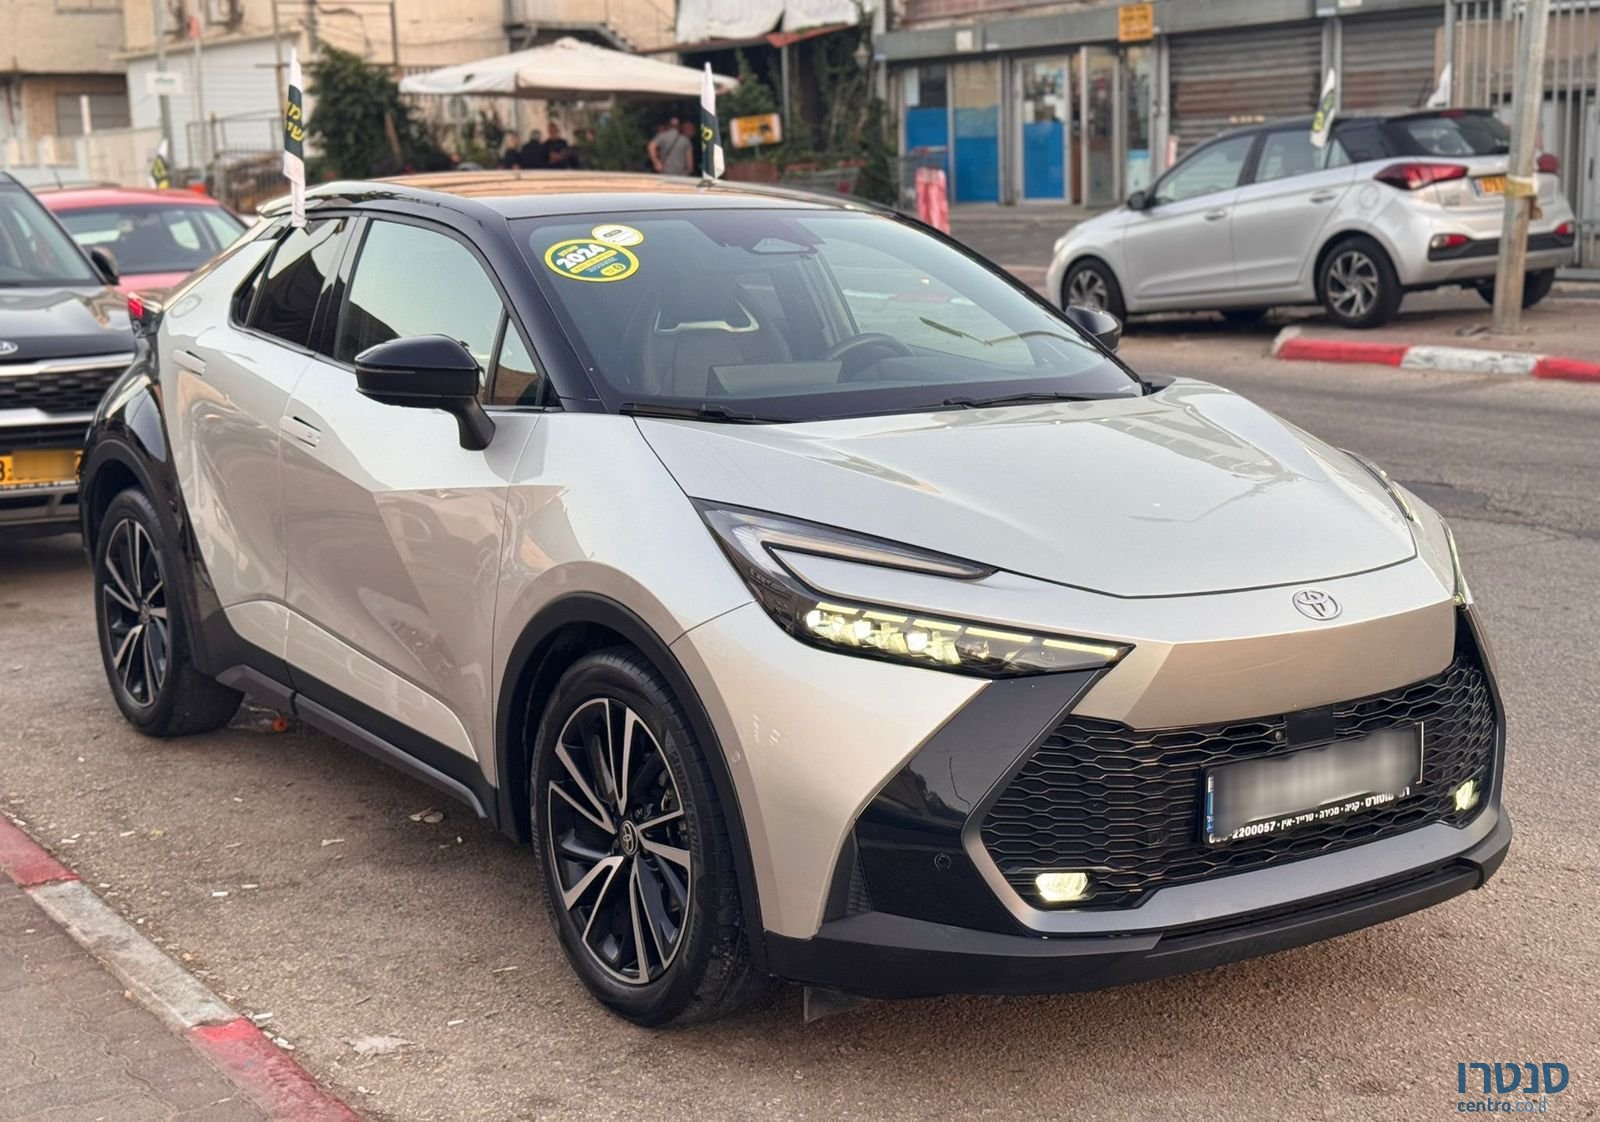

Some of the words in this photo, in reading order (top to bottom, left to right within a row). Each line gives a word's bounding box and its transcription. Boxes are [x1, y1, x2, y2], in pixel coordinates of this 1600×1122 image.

[556, 244, 606, 269] 2024
[1319, 806, 1340, 819] מכירה
[1344, 801, 1360, 813] קניה
